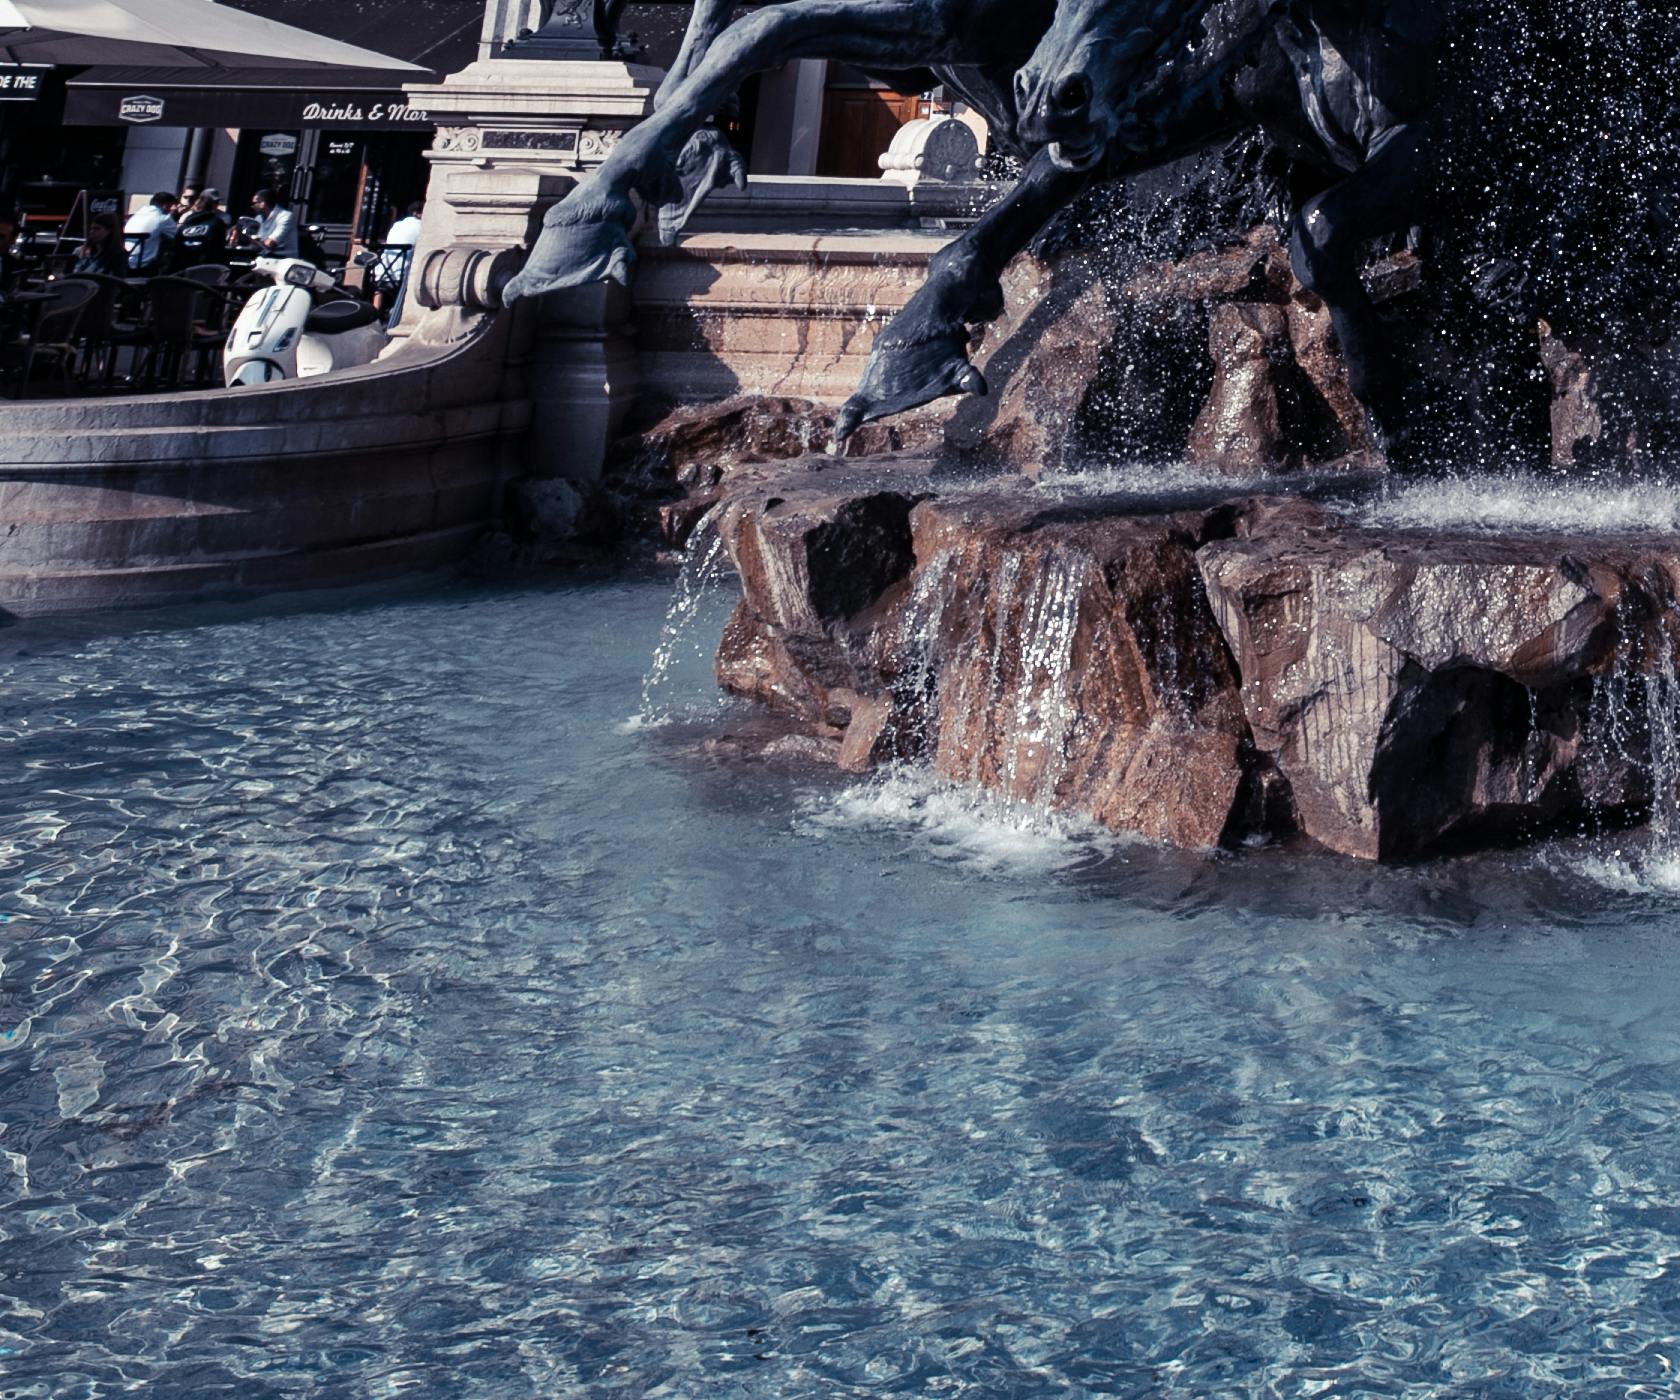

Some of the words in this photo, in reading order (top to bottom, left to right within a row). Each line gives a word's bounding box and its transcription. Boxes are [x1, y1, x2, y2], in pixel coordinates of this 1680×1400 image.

[13, 76, 38, 89] THE
[121, 104, 146, 114] CRAZY
[302, 103, 364, 121] Drinks
[367, 103, 384, 120] &
[388, 104, 429, 121] Mor
